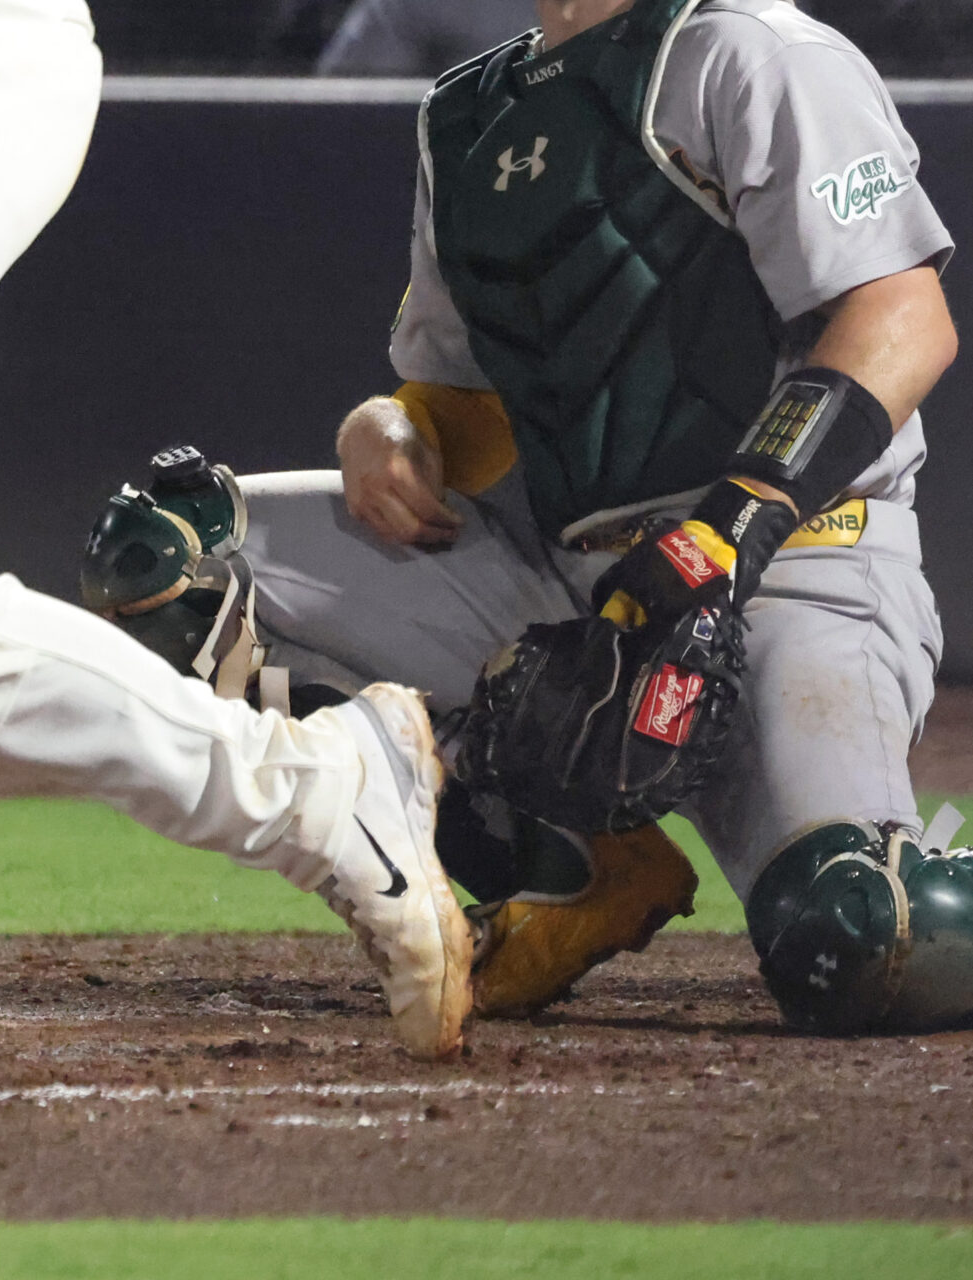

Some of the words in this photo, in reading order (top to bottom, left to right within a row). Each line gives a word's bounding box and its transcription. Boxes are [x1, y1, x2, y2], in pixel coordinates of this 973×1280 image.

[525, 60, 564, 85] LANGY
[859, 158, 887, 179] LAS
[816, 168, 909, 220] Vegas
[670, 536, 712, 576] Rawlings
[652, 673, 683, 734] Rawlings
